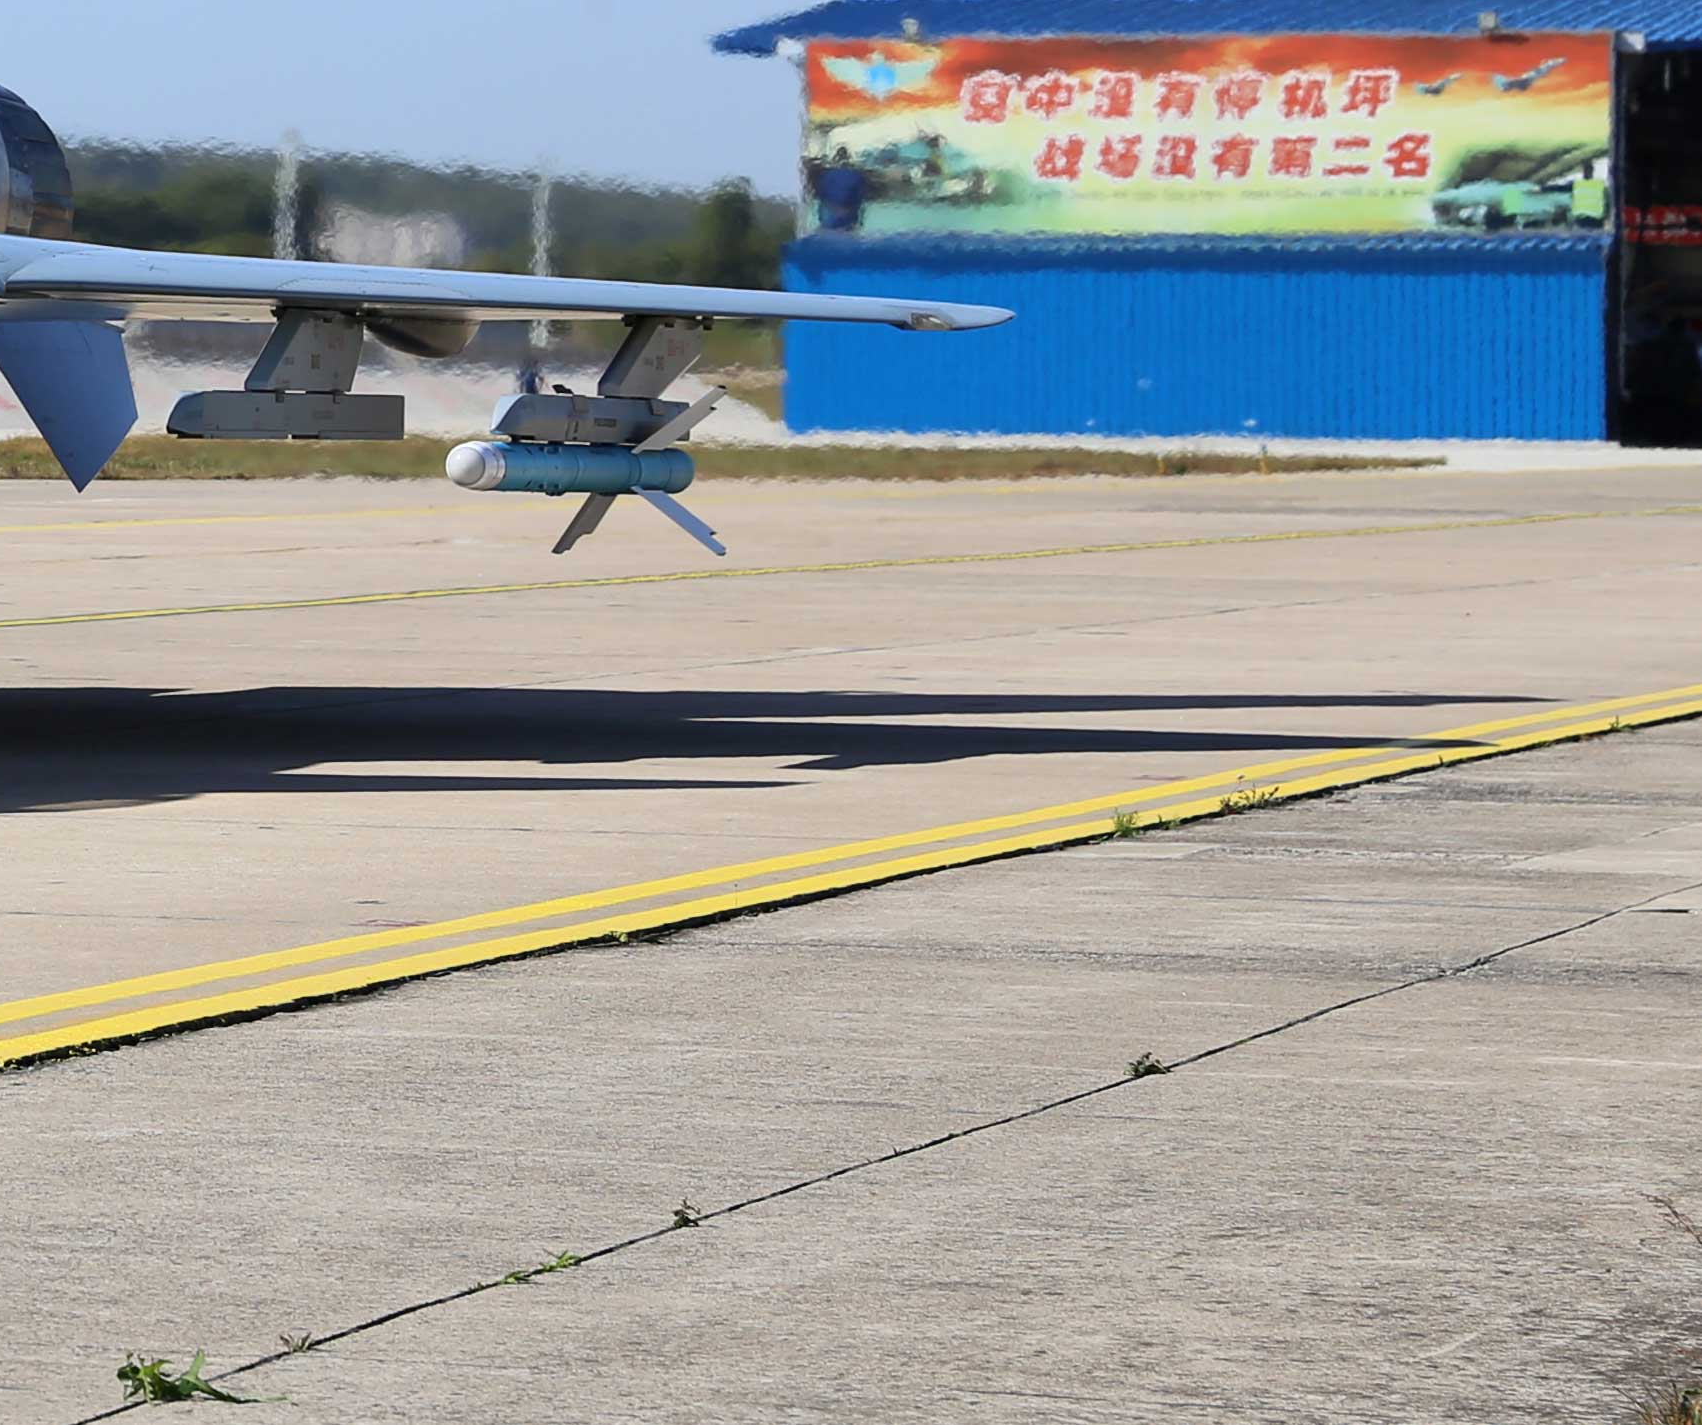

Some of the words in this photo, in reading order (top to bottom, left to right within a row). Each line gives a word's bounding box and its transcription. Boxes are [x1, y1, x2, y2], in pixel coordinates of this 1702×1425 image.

[1034, 133, 1431, 178] 战场没有第二名
